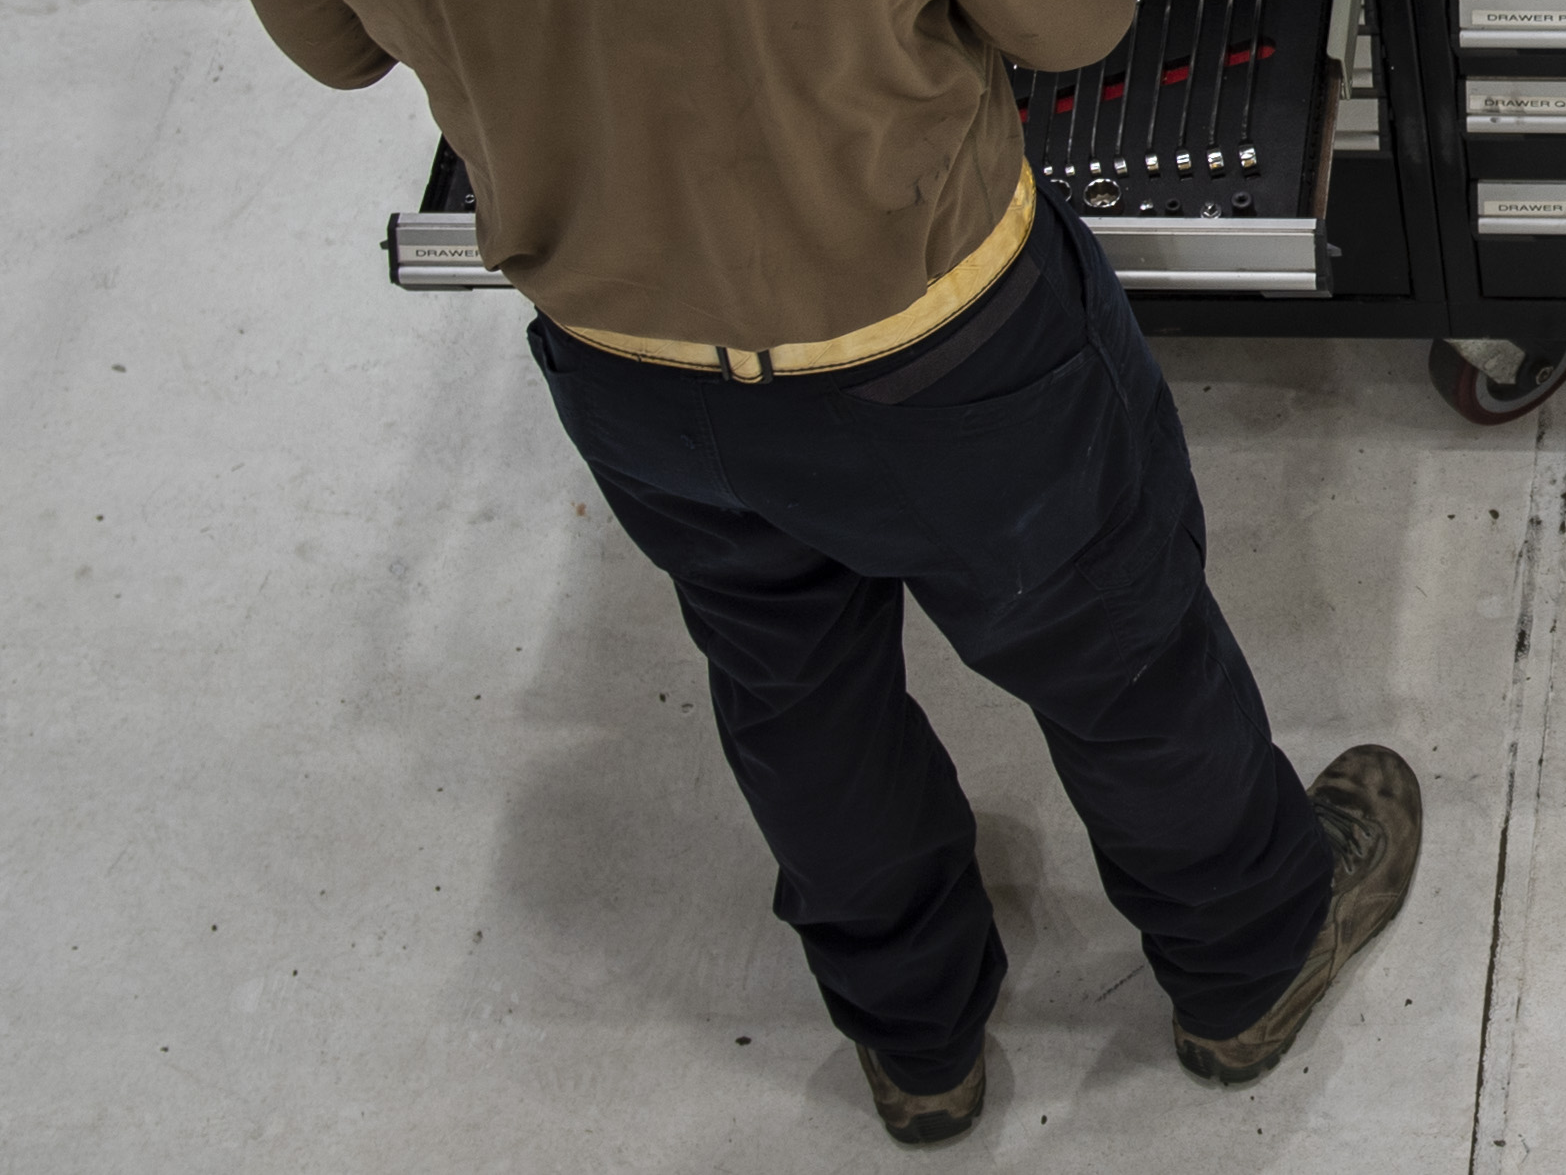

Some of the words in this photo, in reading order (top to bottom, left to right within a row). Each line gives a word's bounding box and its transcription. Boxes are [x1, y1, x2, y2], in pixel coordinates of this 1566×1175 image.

[1487, 14, 1554, 22] DRAWER
[1484, 99, 1550, 107] DRAWER
[1498, 204, 1563, 212] DRAWER
